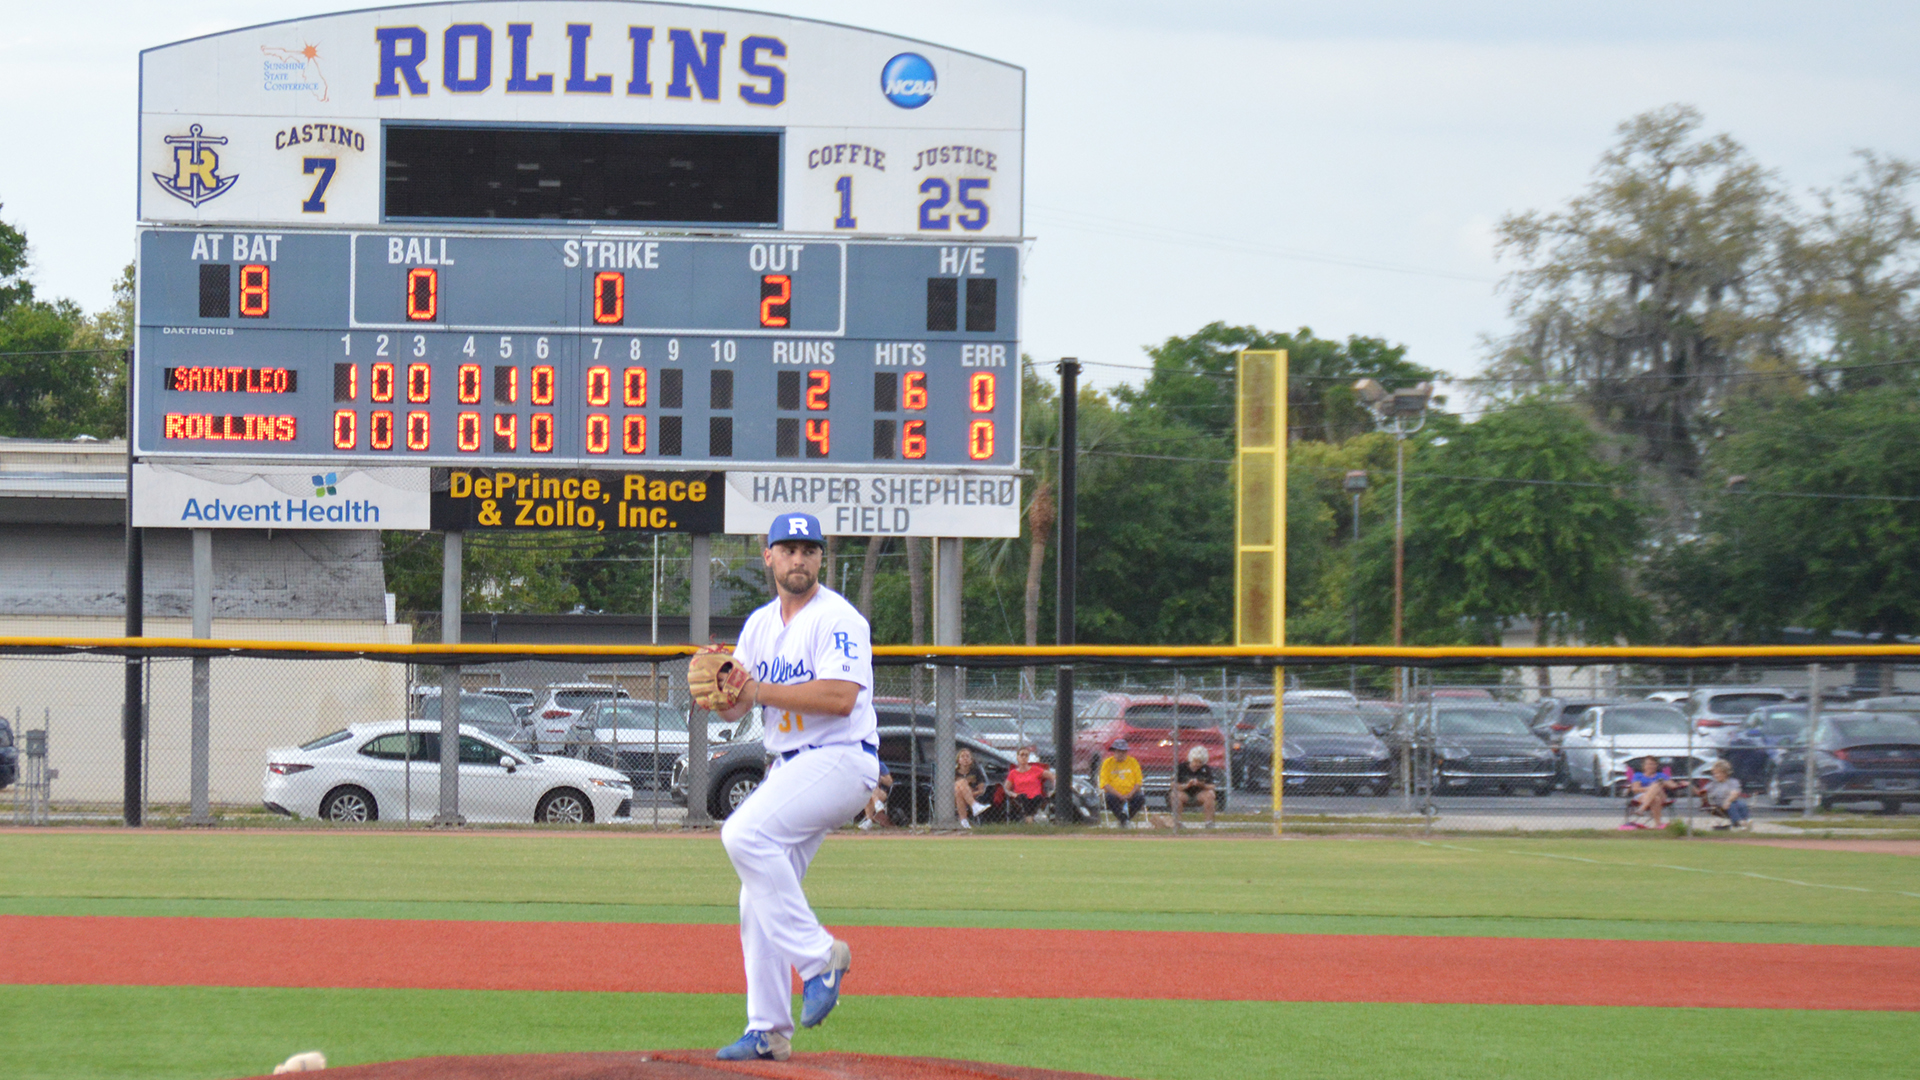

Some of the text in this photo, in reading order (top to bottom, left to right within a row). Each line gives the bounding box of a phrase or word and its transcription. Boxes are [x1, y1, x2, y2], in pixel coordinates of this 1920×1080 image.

[374, 21, 788, 107] ROLLINS
[885, 79, 936, 96] NCAA
[275, 124, 365, 152] CASTINO
[808, 143, 886, 172] COFFIE
[913, 145, 998, 172] JUSTICE
[302, 157, 337, 213] 7
[834, 174, 857, 230] 1
[918, 176, 991, 232] 25
[191, 234, 282, 262] AT BAT
[388, 237, 455, 265] BALL
[563, 240, 660, 269] STRIKE
[749, 244, 804, 272] OUT
[939, 247, 986, 277] H/E
[239, 263, 270, 317] 8
[406, 267, 437, 321] 0
[594, 271, 625, 324] 0
[760, 274, 791, 327] 2
[163, 327, 234, 335] DAKTRONICS
[341, 334, 737, 363] 1 2 3 4 5 6 7 8 9 10
[772, 341, 835, 365] RUNS
[875, 343, 926, 367] HITS
[961, 344, 1006, 367] ERR
[349, 363, 358, 400] 1
[371, 362, 394, 402] 0
[408, 362, 431, 403] 0
[458, 363, 481, 404] 0
[508, 366, 518, 403] 1
[531, 365, 554, 405] 0
[587, 365, 611, 407] 0
[624, 366, 647, 407] 0
[806, 369, 831, 410] 2
[902, 370, 928, 410] 6
[969, 371, 996, 413] 0
[165, 408, 995, 460] ROLLINS 0 0 0 0 4 0 0 0 4 6 0
[450, 472, 707, 504] DePrince, Race
[753, 476, 1015, 507] HARPER SHEPHERD
[477, 499, 678, 531] & Zollo, Inc.
[788, 517, 809, 535] R
[836, 507, 910, 533] FIELD
